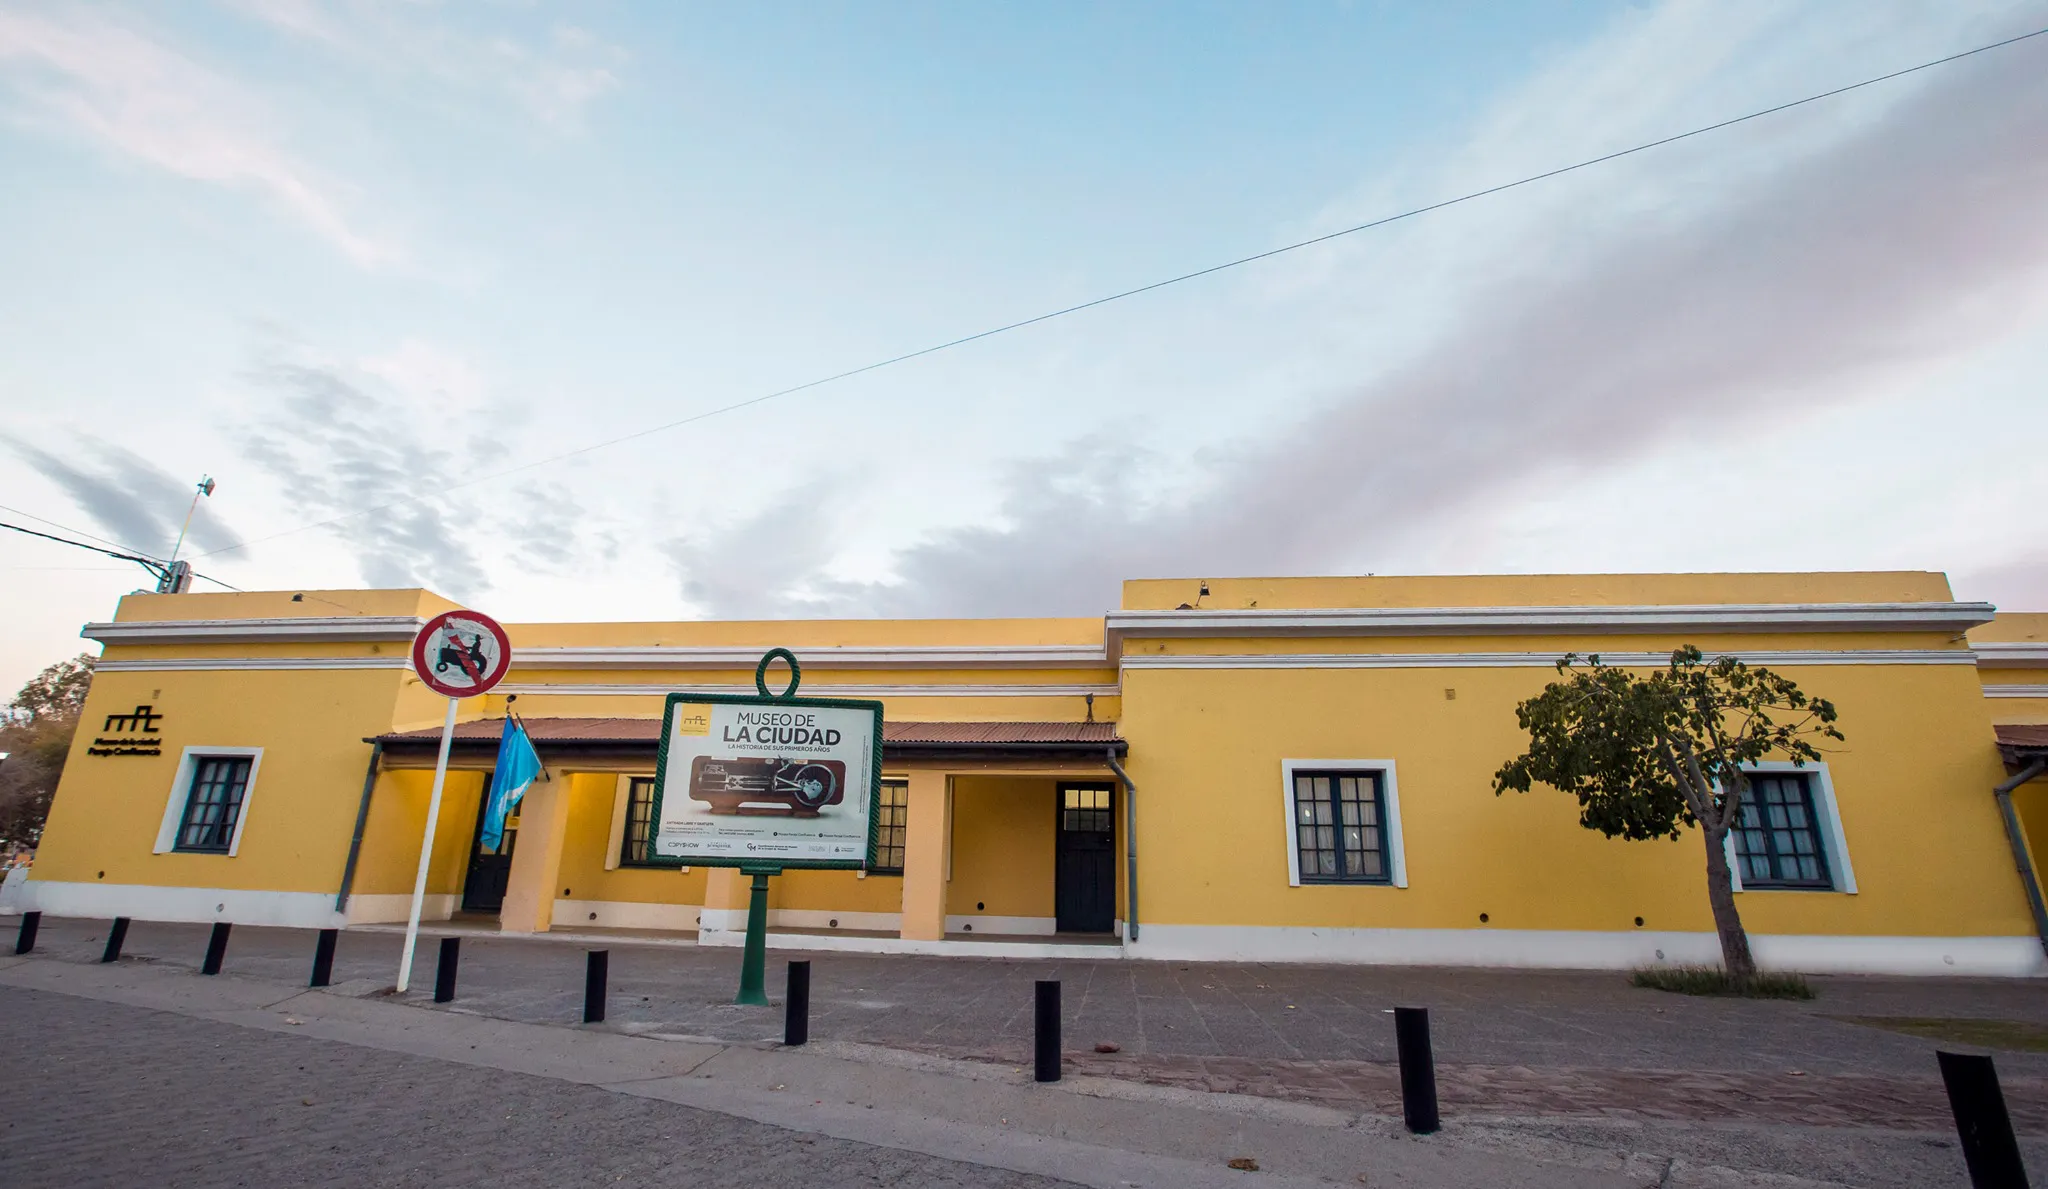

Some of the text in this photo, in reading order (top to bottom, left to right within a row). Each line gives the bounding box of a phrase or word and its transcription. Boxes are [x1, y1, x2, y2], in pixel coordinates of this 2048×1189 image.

[737, 712, 816, 727] MUSEO DE
[723, 725, 752, 743] LA
[756, 726, 842, 746] CIUDAD
[813, 745, 831, 753] AÑOS
